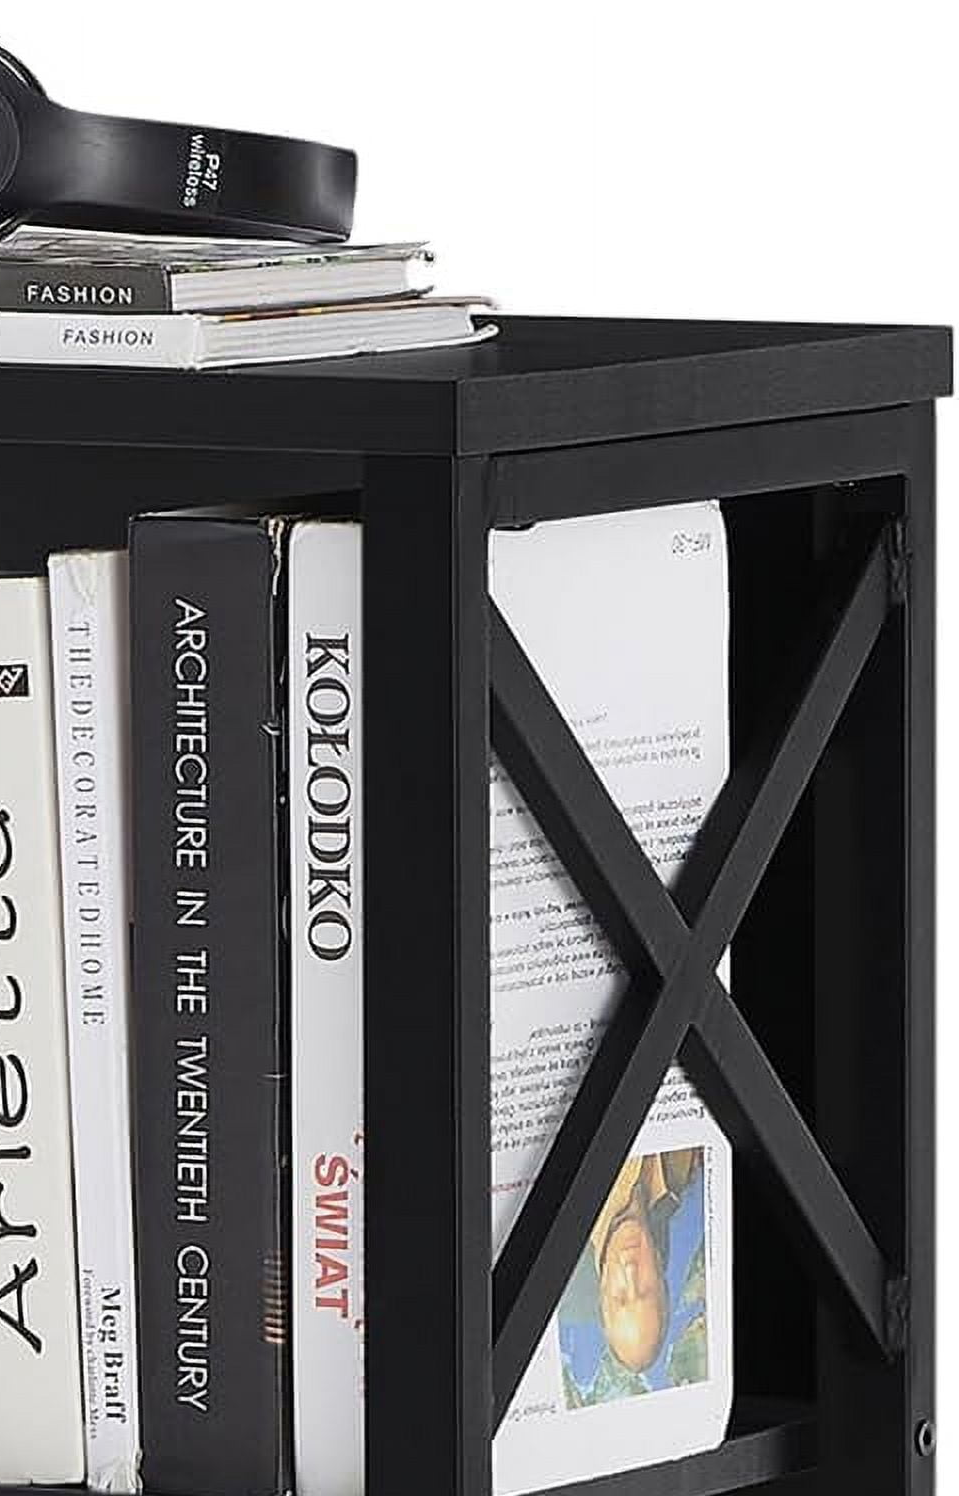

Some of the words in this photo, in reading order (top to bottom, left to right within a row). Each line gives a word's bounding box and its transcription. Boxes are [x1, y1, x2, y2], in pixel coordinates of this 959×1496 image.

[201, 153, 221, 192] P47
[26, 284, 134, 305] FASHION
[62, 328, 155, 347] FASHION
[174, 597, 208, 868] ARCHITECTURE
[305, 632, 353, 962] KOŁODKO
[175, 891, 208, 927] IN
[175, 950, 208, 1014] THE
[176, 1036, 209, 1222] TWENTIETH
[314, 1151, 359, 1319] ŚWIAT
[98, 1286, 122, 1344] Meg
[176, 1245, 210, 1412] CENTURY
[103, 1351, 127, 1424] Braff
